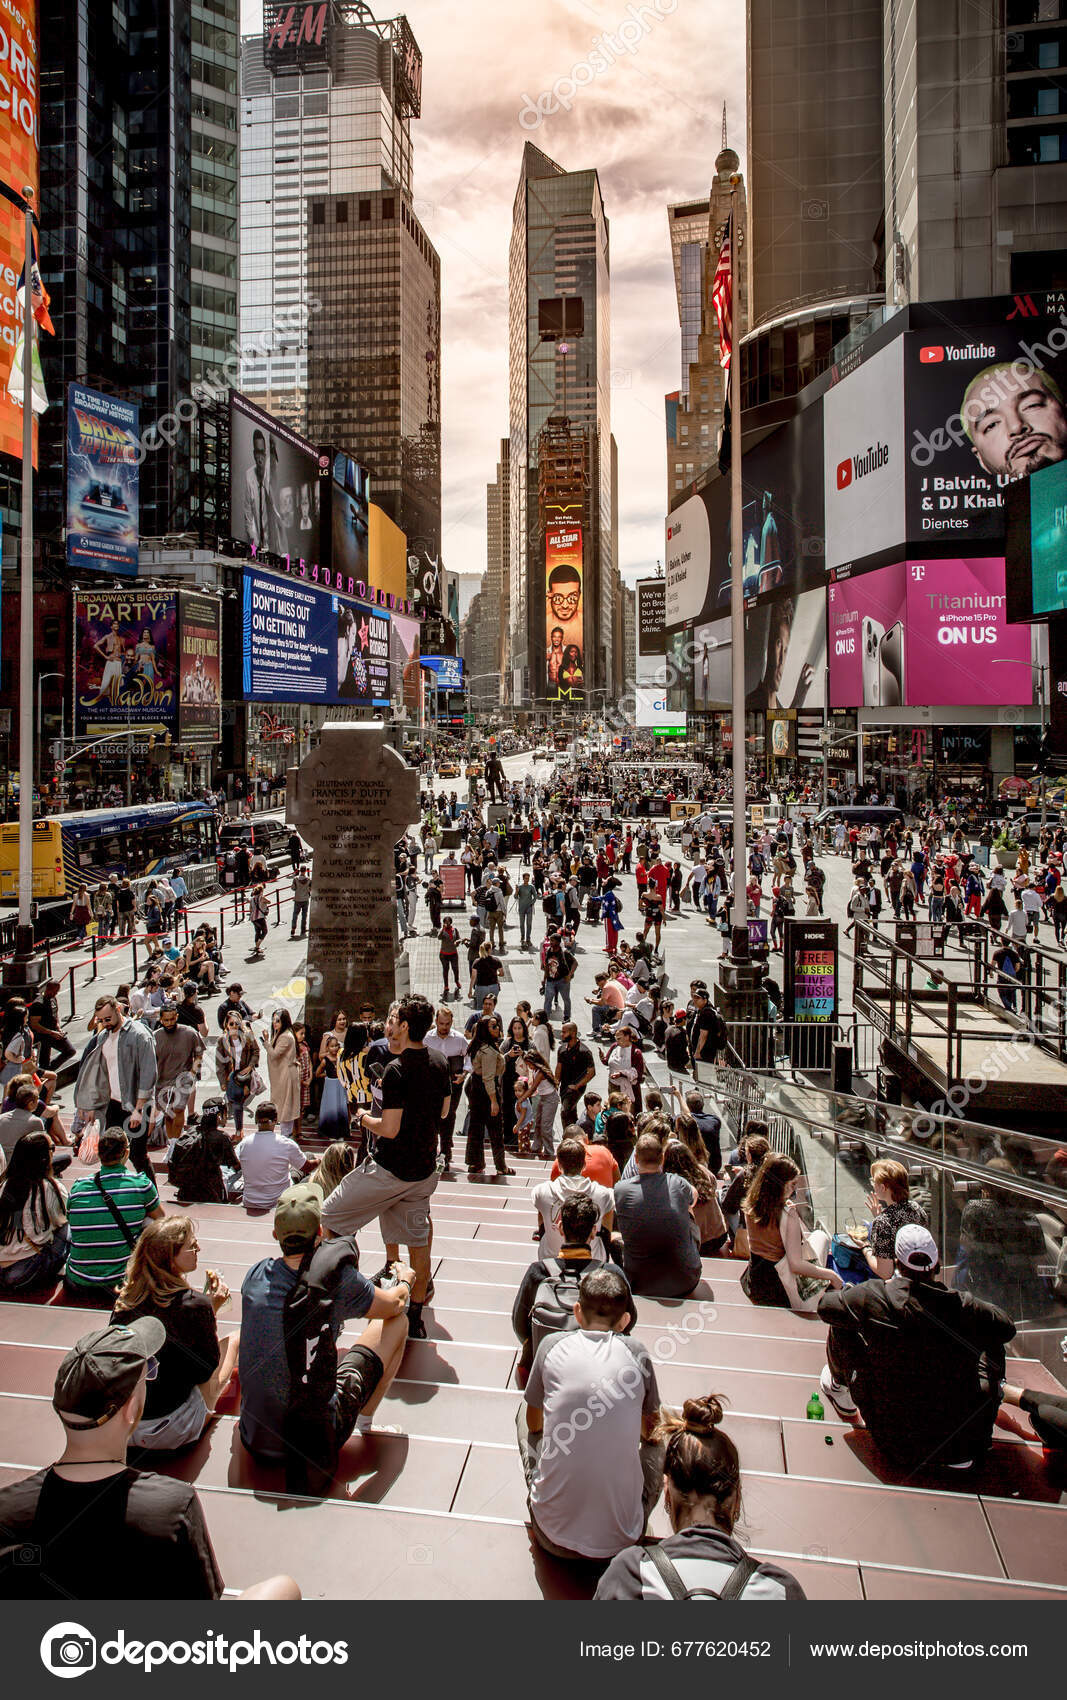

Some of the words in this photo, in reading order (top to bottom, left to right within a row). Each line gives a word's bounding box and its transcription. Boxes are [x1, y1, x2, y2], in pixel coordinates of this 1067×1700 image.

[267, 3, 329, 49] H&M
[945, 342, 996, 361] YouTube
[74, 397, 108, 414] BROADWAY
[87, 394, 101, 405] TIME
[102, 400, 110, 409] TO
[111, 403, 134, 417] CHANGE
[72, 406, 130, 444] BACK
[853, 441, 889, 480] YouTube
[921, 476, 928, 492] J
[933, 474, 992, 492] Balvin,
[921, 497, 934, 511] &
[938, 496, 959, 511] DJ
[963, 493, 1005, 509] Khal
[922, 518, 969, 530] Dientes
[550, 536, 561, 545] ALL
[561, 534, 578, 543] STAR
[253, 578, 276, 593] AMERICAN
[336, 572, 412, 615] BROADWAY
[77, 594, 135, 603] BROADWAY'S
[136, 592, 176, 601] BIGGEST
[642, 591, 661, 599] We're
[87, 602, 168, 622] PARTY!
[252, 592, 278, 614] DON'T
[277, 599, 296, 618] MISS
[296, 604, 310, 621] OUT
[252, 613, 265, 631] ON
[266, 616, 297, 638] GETTING
[298, 623, 306, 639] IN
[945, 613, 973, 622] iPhone
[983, 613, 997, 621] Pro
[369, 616, 388, 641] OLIVIA
[937, 626, 968, 645] ON
[971, 625, 997, 645] US
[835, 639, 846, 656] ON
[845, 638, 855, 655] US
[79, 673, 173, 707] Aladdin
[827, 748, 849, 759] EPHORA
[312, 788, 349, 797] FRANCIS
[360, 788, 392, 797] DUFFY
[800, 953, 828, 963] FREE
[797, 966, 809, 974] DJ
[811, 965, 833, 974] SETS
[801, 999, 827, 1009] JAZZ
